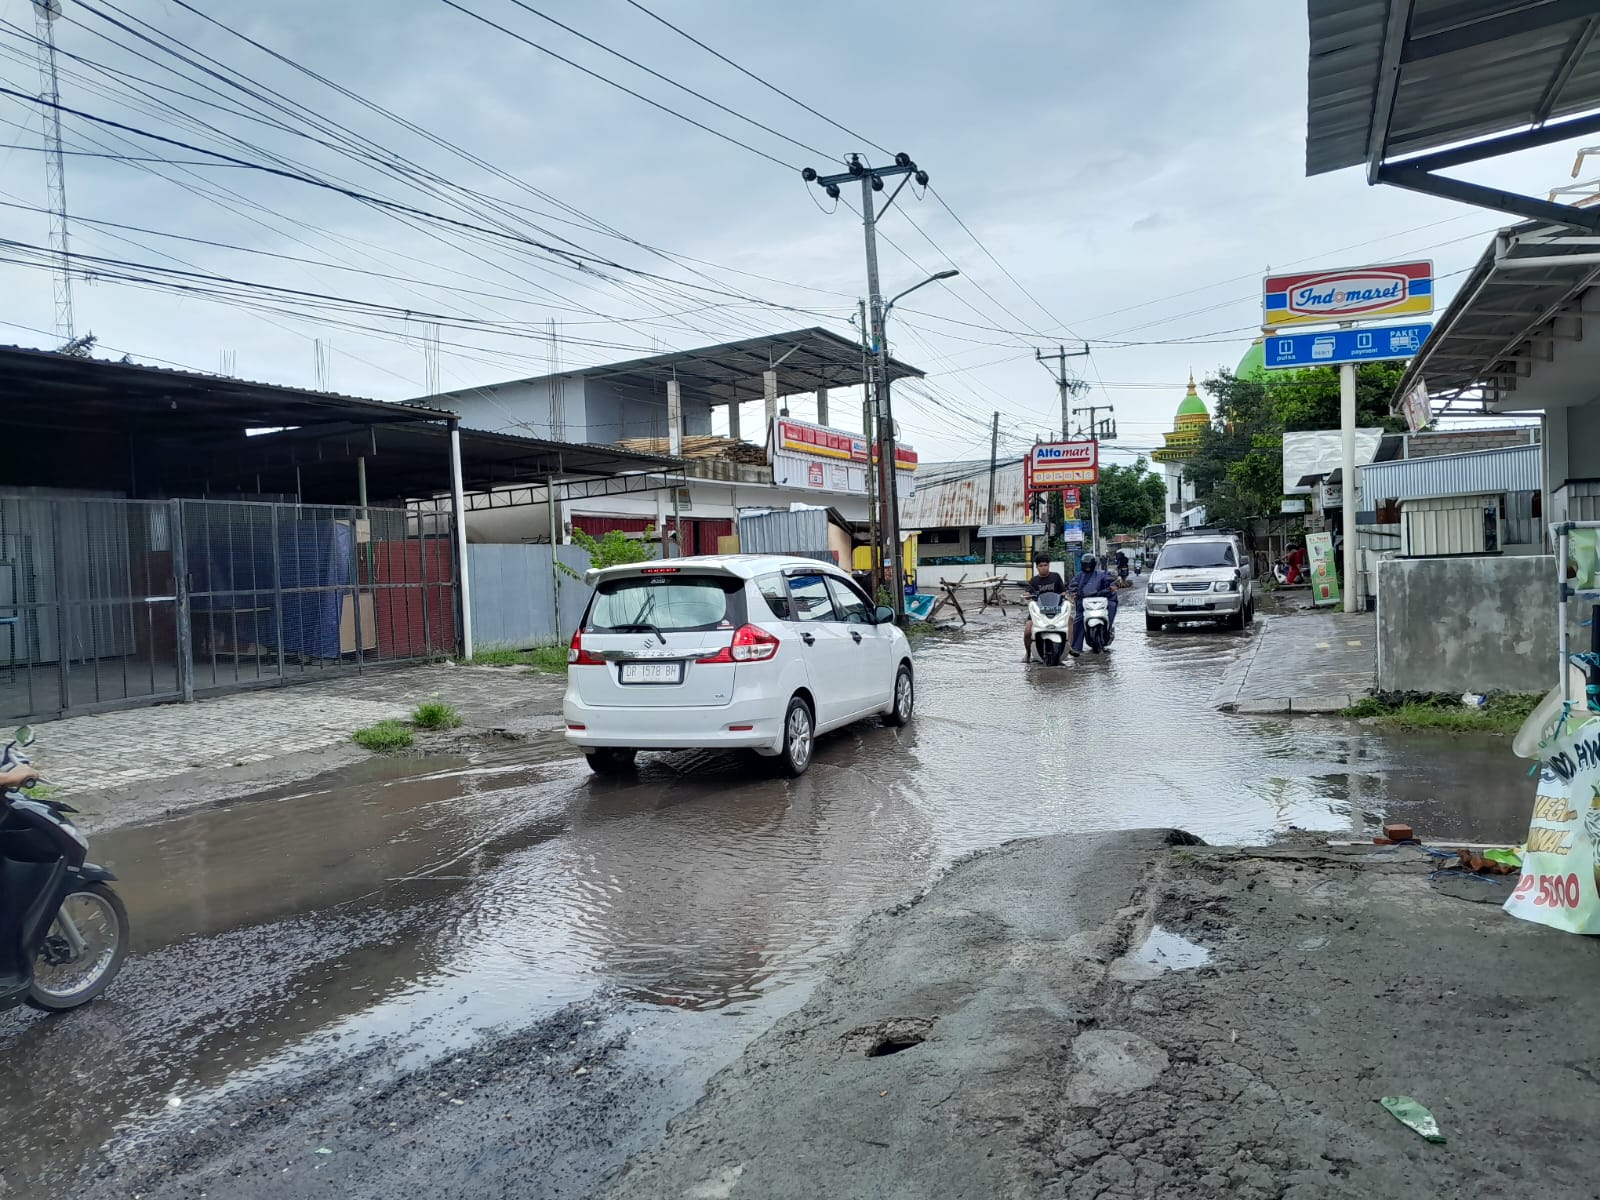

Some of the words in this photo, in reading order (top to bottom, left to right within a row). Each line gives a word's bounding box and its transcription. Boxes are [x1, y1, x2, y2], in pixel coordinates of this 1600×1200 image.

[1295, 281, 1400, 306] Indomaret
[1390, 329, 1420, 337] PAKET
[1350, 347, 1379, 356] payment
[1276, 353, 1297, 362] pulsa
[1036, 446, 1090, 458] Alfamart
[626, 666, 637, 677] DR
[642, 665, 661, 677] 1578
[665, 665, 677, 677] BH
